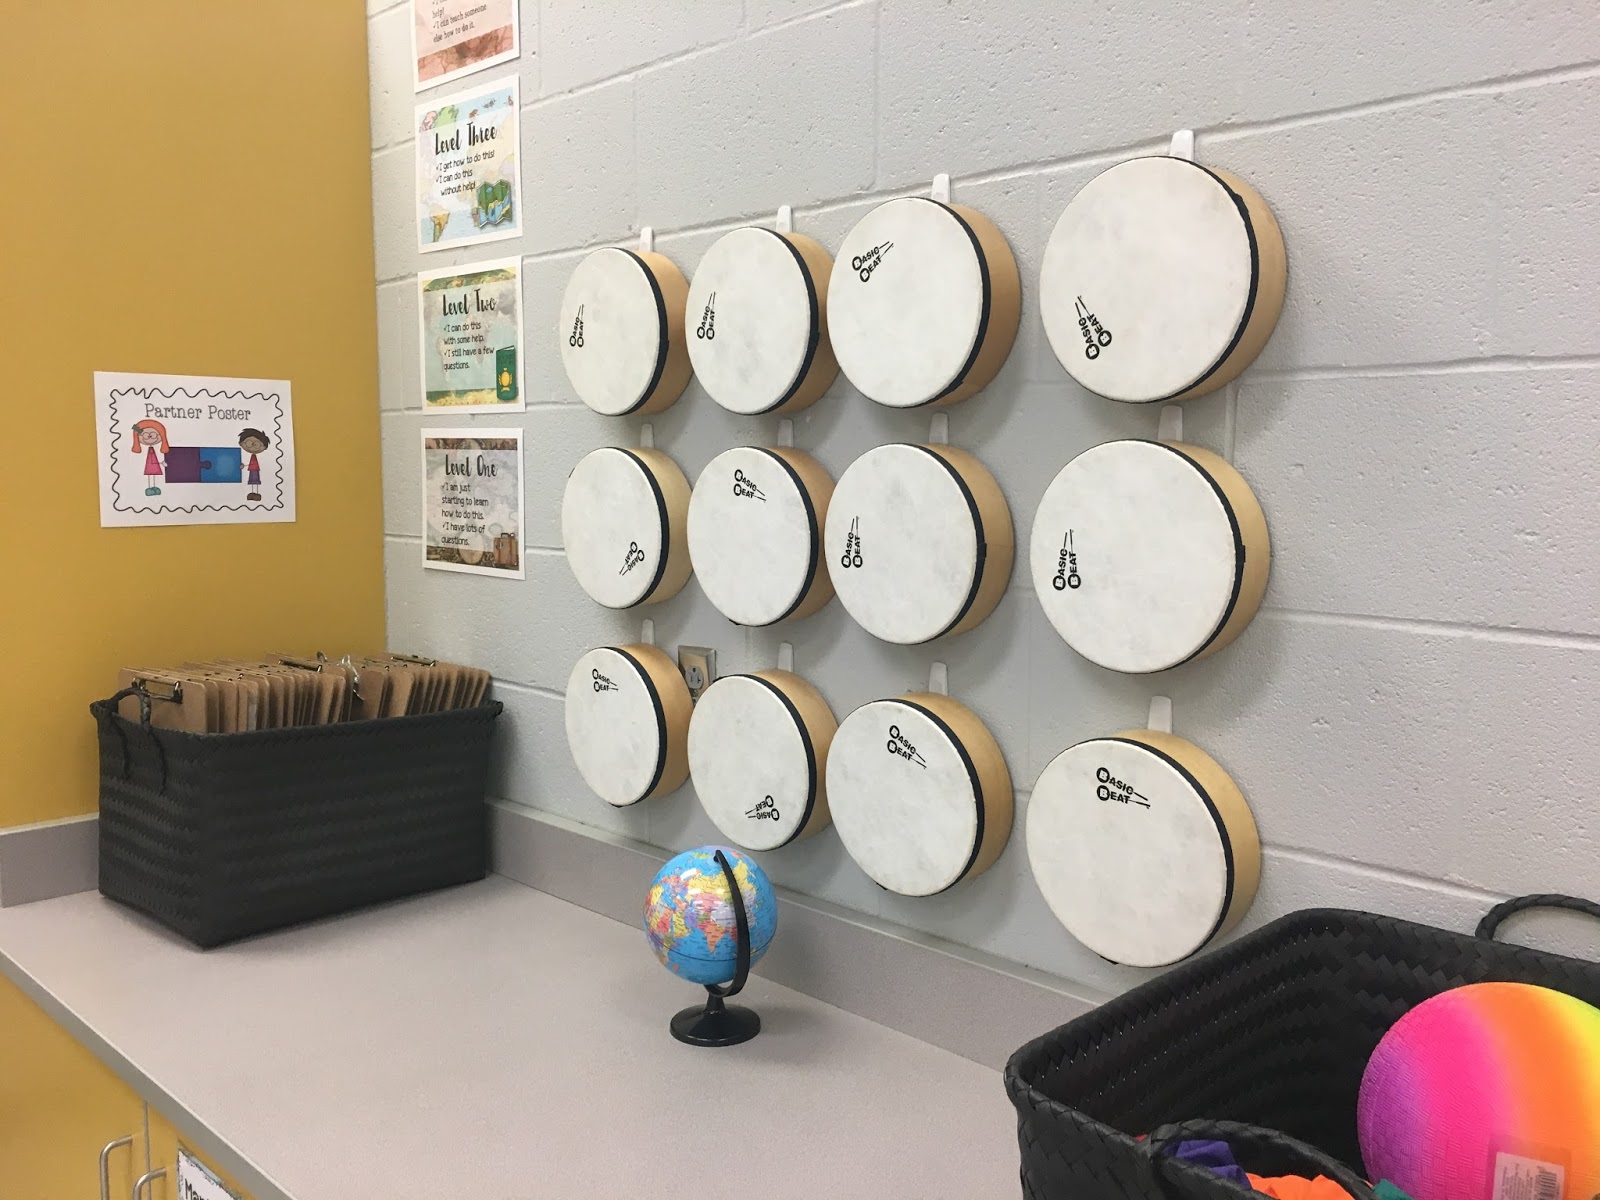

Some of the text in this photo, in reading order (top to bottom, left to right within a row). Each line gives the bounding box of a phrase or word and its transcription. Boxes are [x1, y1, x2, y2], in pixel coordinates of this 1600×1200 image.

[450, 12, 464, 24] teach
[464, 4, 486, 18] someone
[433, 34, 442, 42] else
[444, 30, 454, 38] how
[435, 122, 497, 155] Level Three
[443, 160, 452, 172] get
[453, 159, 465, 167] how
[466, 156, 472, 164] to
[474, 153, 481, 162] do
[483, 150, 495, 160] this!
[443, 174, 453, 182] can
[454, 172, 461, 180] do
[462, 169, 473, 178] this
[441, 181, 476, 196] without help!
[443, 288, 497, 316] Level Two
[471, 322, 481, 330] this
[443, 334, 484, 345] with some help.
[452, 349, 461, 357] still
[463, 348, 476, 356] have
[483, 346, 495, 354] few
[444, 362, 470, 372] questions.
[144, 403, 251, 421] Partner Poster
[446, 454, 498, 477] Level One
[459, 483, 471, 494] just
[442, 496, 489, 507] starting to learn
[442, 509, 484, 520] how to do this.
[451, 524, 465, 532] have
[466, 524, 477, 533] lots
[478, 525, 485, 533] of
[441, 536, 469, 546] questions.
[1053, 549, 1068, 591] BASIC
[1067, 551, 1081, 589] BEAT
[1096, 767, 1133, 795] BASIC
[1097, 785, 1130, 804] BEAT
